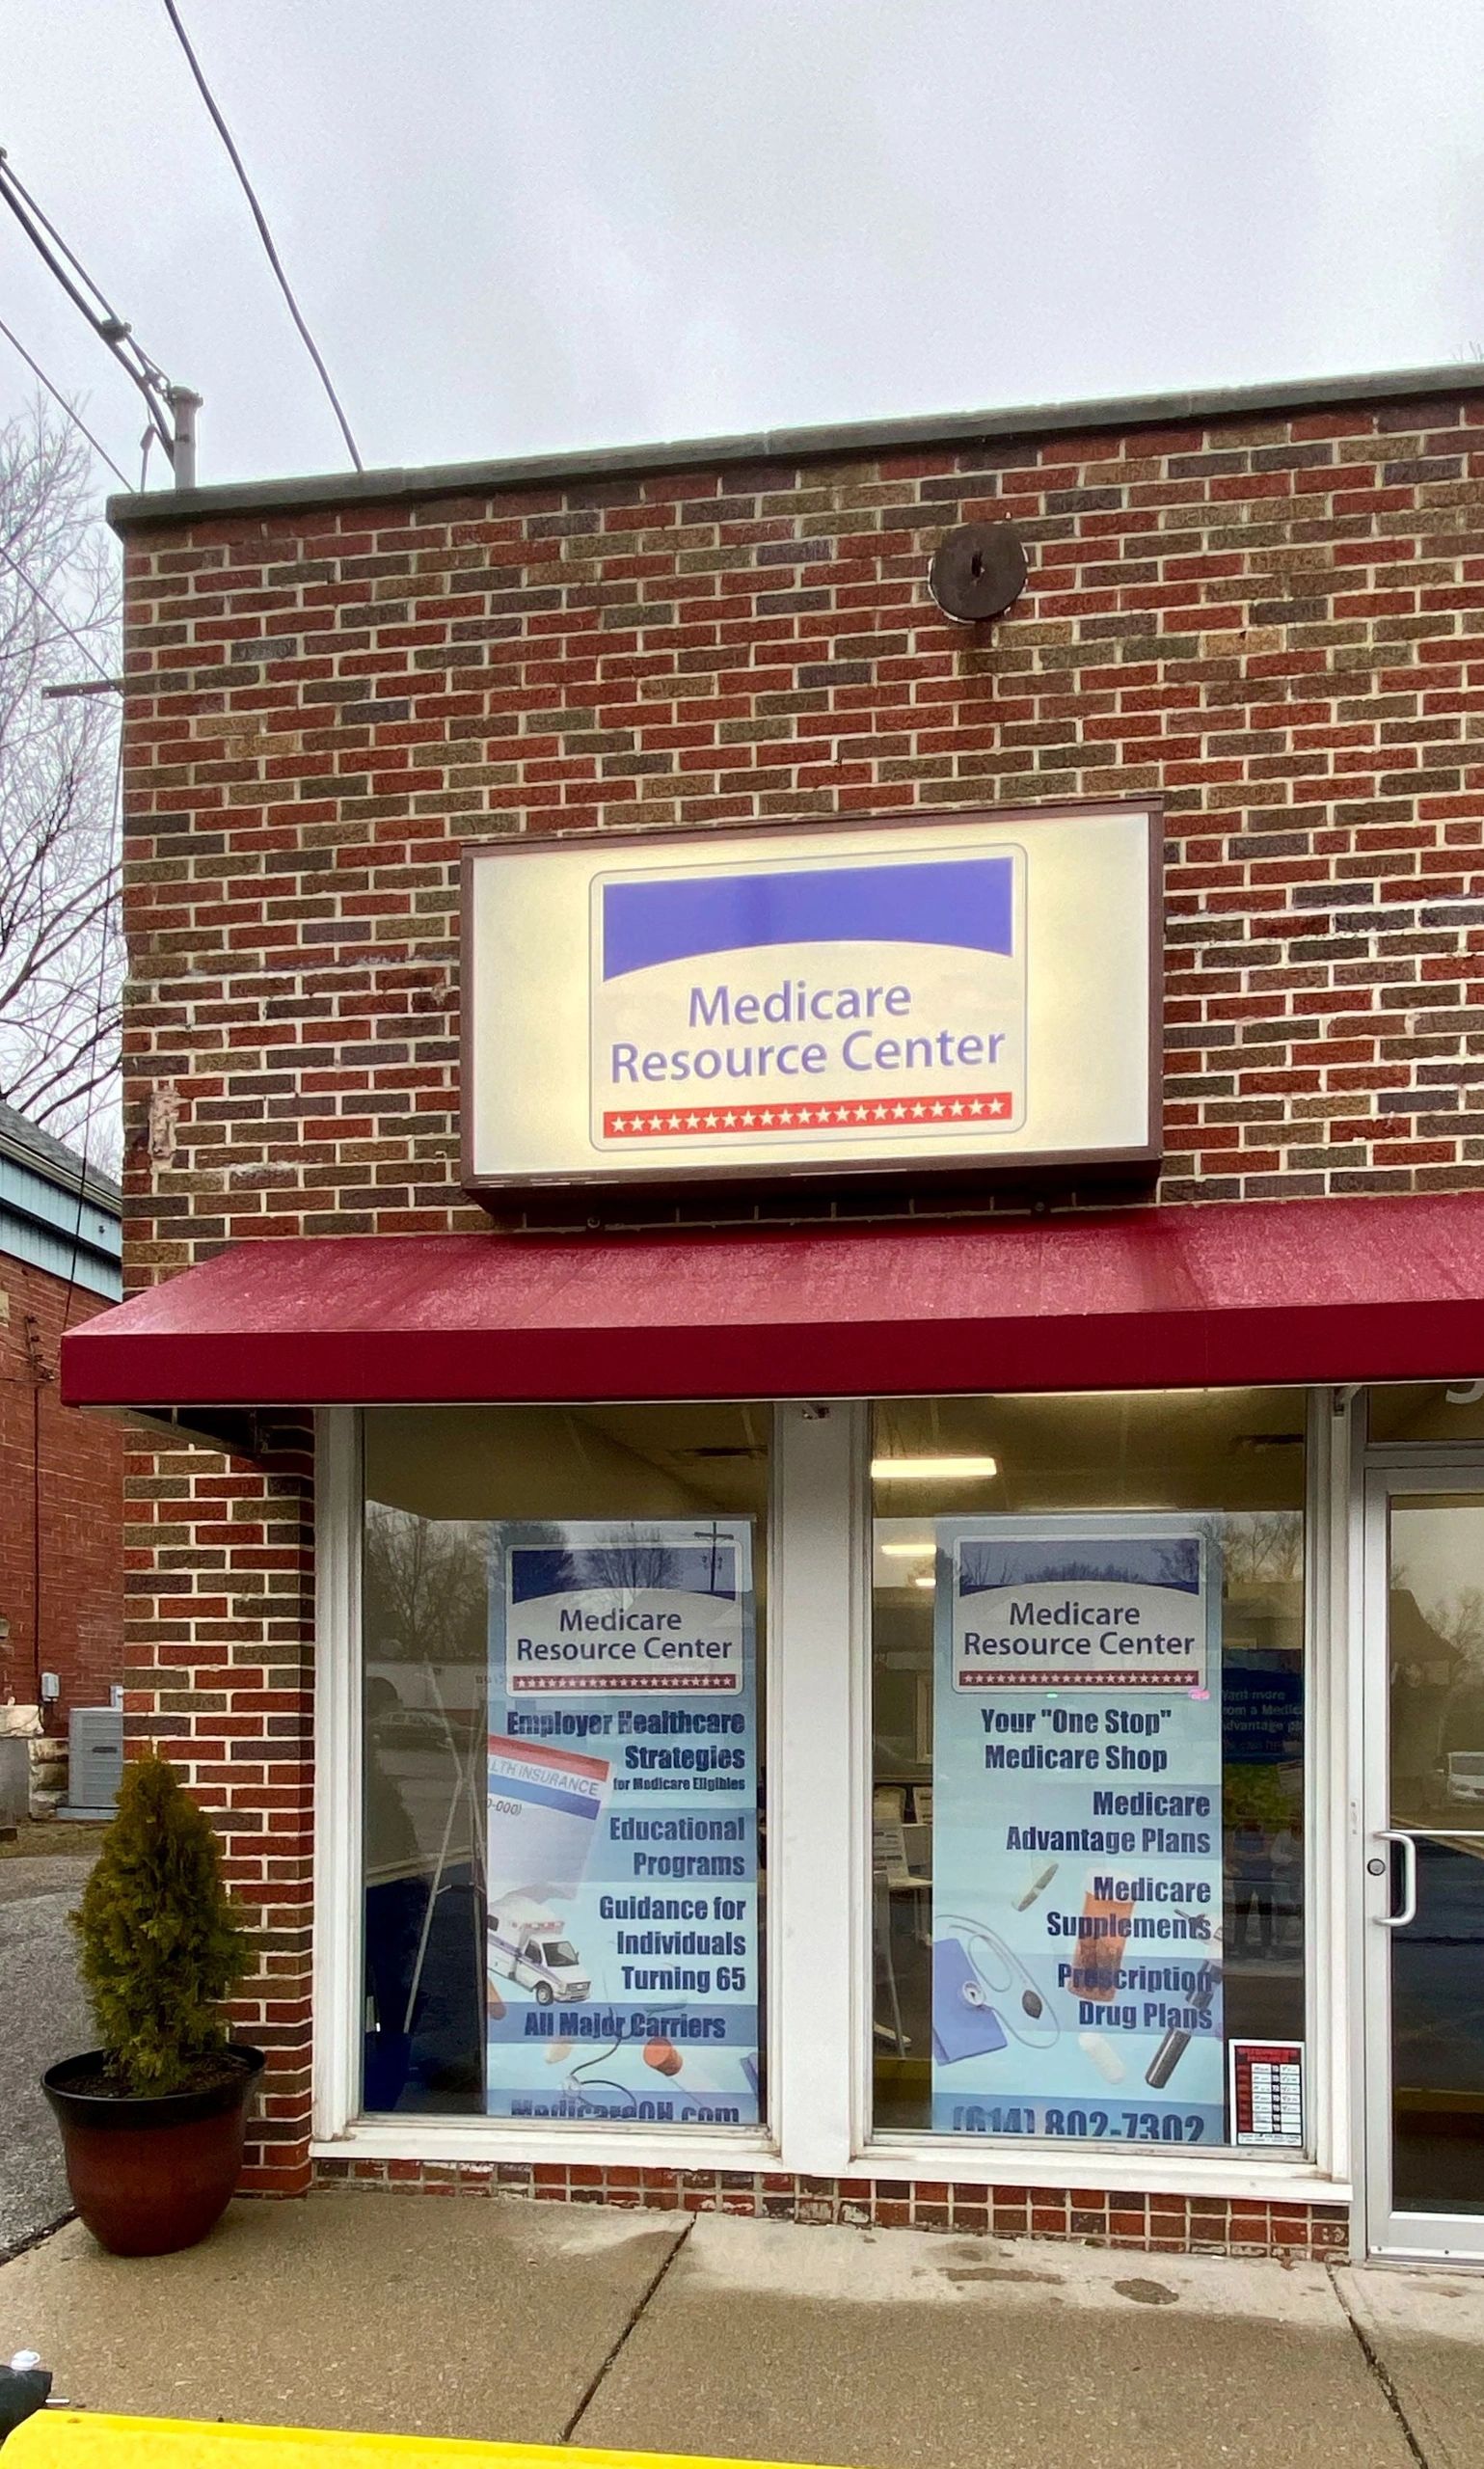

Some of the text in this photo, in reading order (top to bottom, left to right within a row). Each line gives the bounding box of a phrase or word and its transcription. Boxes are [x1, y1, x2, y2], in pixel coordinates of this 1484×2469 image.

[688, 980, 912, 1028] Medicare
[610, 1028, 1007, 1085] Resource Center
[558, 1608, 683, 1632] Medicare
[1009, 1601, 1142, 1626] Medicare
[517, 1636, 733, 1661] Resource Center
[963, 1631, 1195, 1656] Resource Center
[506, 1710, 746, 1737] Employer Healthcare
[981, 1708, 1173, 1737] Your "One Stop"
[624, 1745, 746, 1772] Strategies
[985, 1745, 1168, 1774] Medicare Shop
[517, 1767, 600, 1796] INSURANCE
[613, 1777, 746, 1792] for Medicare Eligibles
[1093, 1791, 1210, 1816] Medicare
[609, 1817, 745, 1841] Educational
[1006, 1826, 1211, 1855] Advantage Plans
[633, 1852, 745, 1878] Programs
[1093, 1876, 1211, 1903] Medicare
[599, 1896, 747, 1920] Guidance for
[1047, 1912, 1211, 1940] Supplements
[617, 1931, 746, 1956] Individuals
[621, 1966, 746, 1994] Turning 65
[1057, 1964, 1212, 1993] Prescription
[525, 2012, 726, 2038] All Major Carriers
[1079, 2001, 1213, 2030] Drug Plans
[1044, 2109, 1205, 2142] 802-7302
